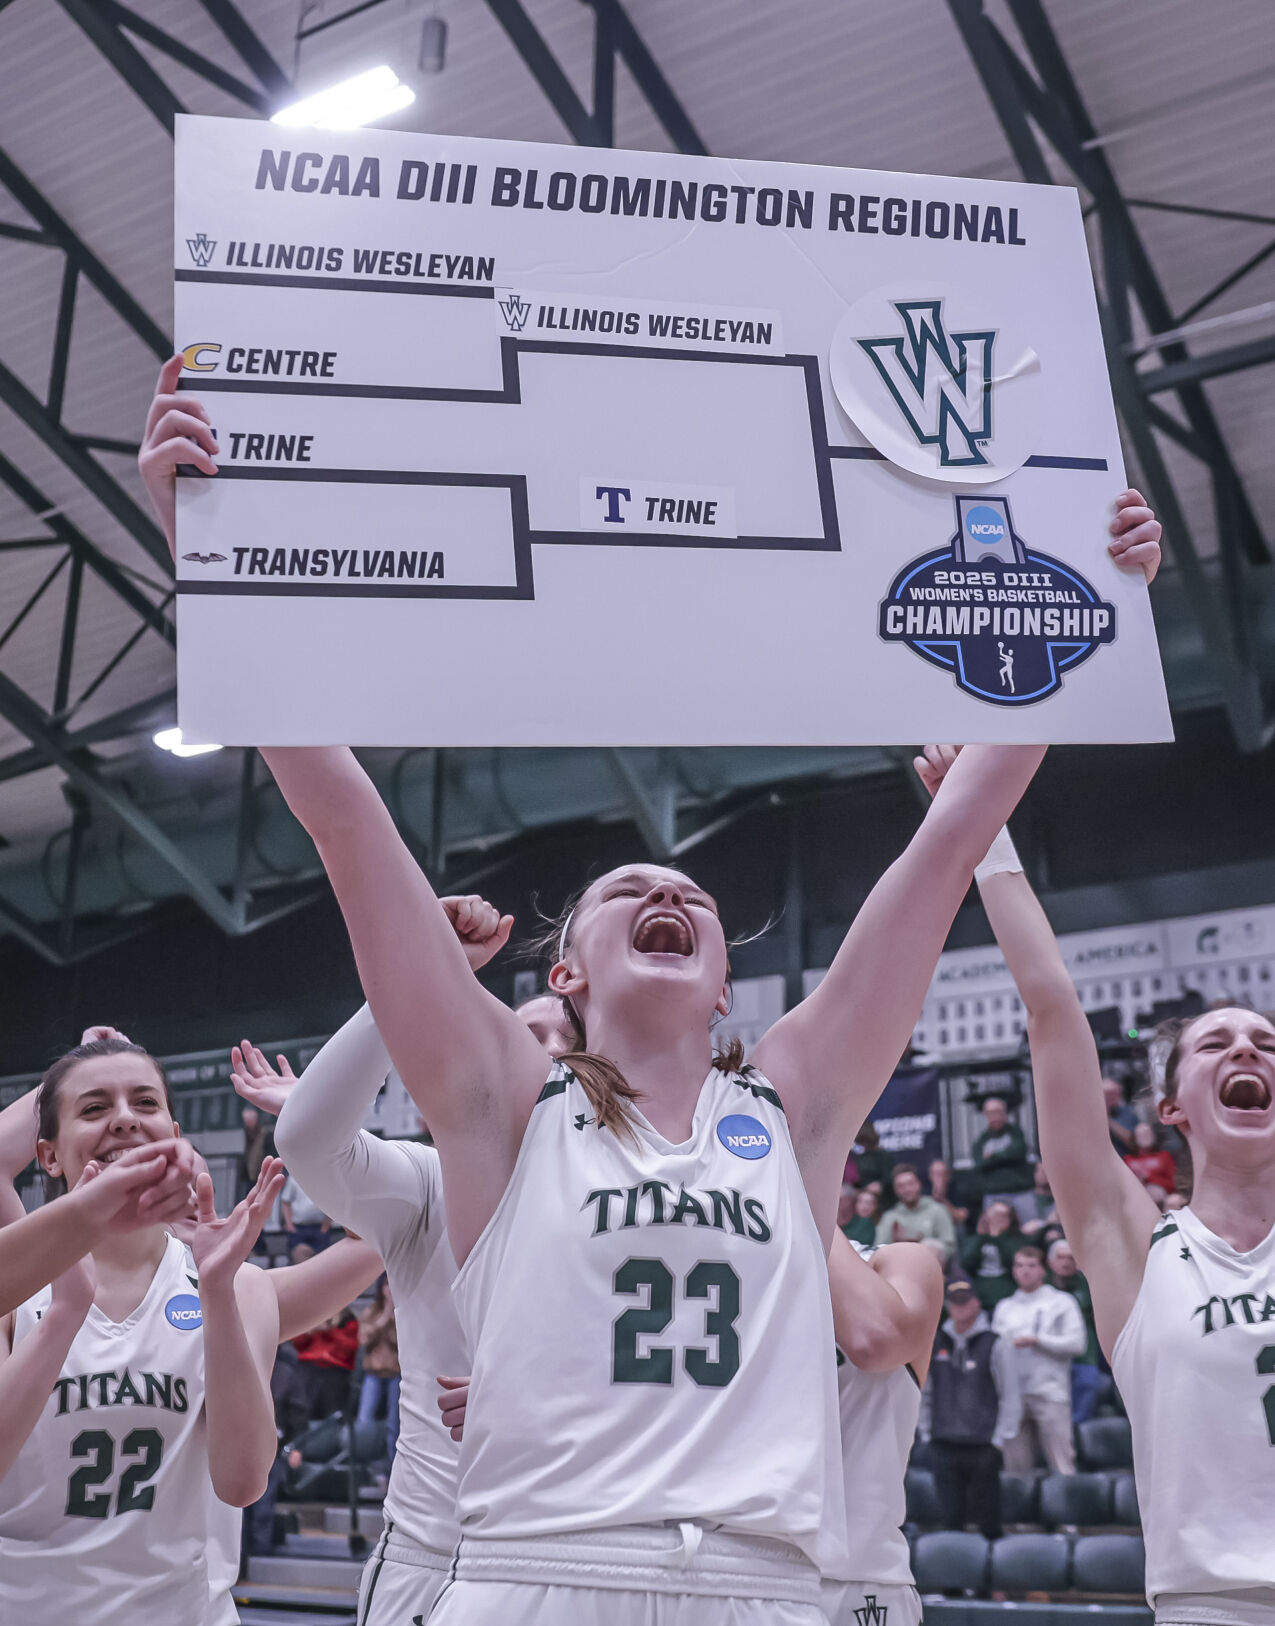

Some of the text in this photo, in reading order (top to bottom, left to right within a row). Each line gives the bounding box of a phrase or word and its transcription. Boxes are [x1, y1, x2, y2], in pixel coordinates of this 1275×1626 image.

[255, 149, 1026, 246] NCAA DIII BLOOMINGTON REGIONAL
[226, 241, 495, 281] ILLINOIS WESLEYAN
[537, 306, 772, 345] ILLINOIS WESLEYAN
[226, 348, 337, 377] CENTRE
[229, 433, 314, 462] TRINE
[645, 497, 717, 525] TRINE
[971, 524, 1005, 536] NCAA
[232, 547, 445, 579] TRANSYLVANIA
[934, 571, 1053, 587] 2025 DIII
[910, 588, 1081, 603] WOMEN'S BASKETBALL
[886, 605, 1110, 637] CHAMPIONSHIP
[726, 1134, 769, 1147] NCAA
[579, 1178, 772, 1245] TITANS
[611, 1255, 742, 1389] 23
[52, 1366, 188, 1418] TITANS
[63, 1427, 165, 1520] 22
